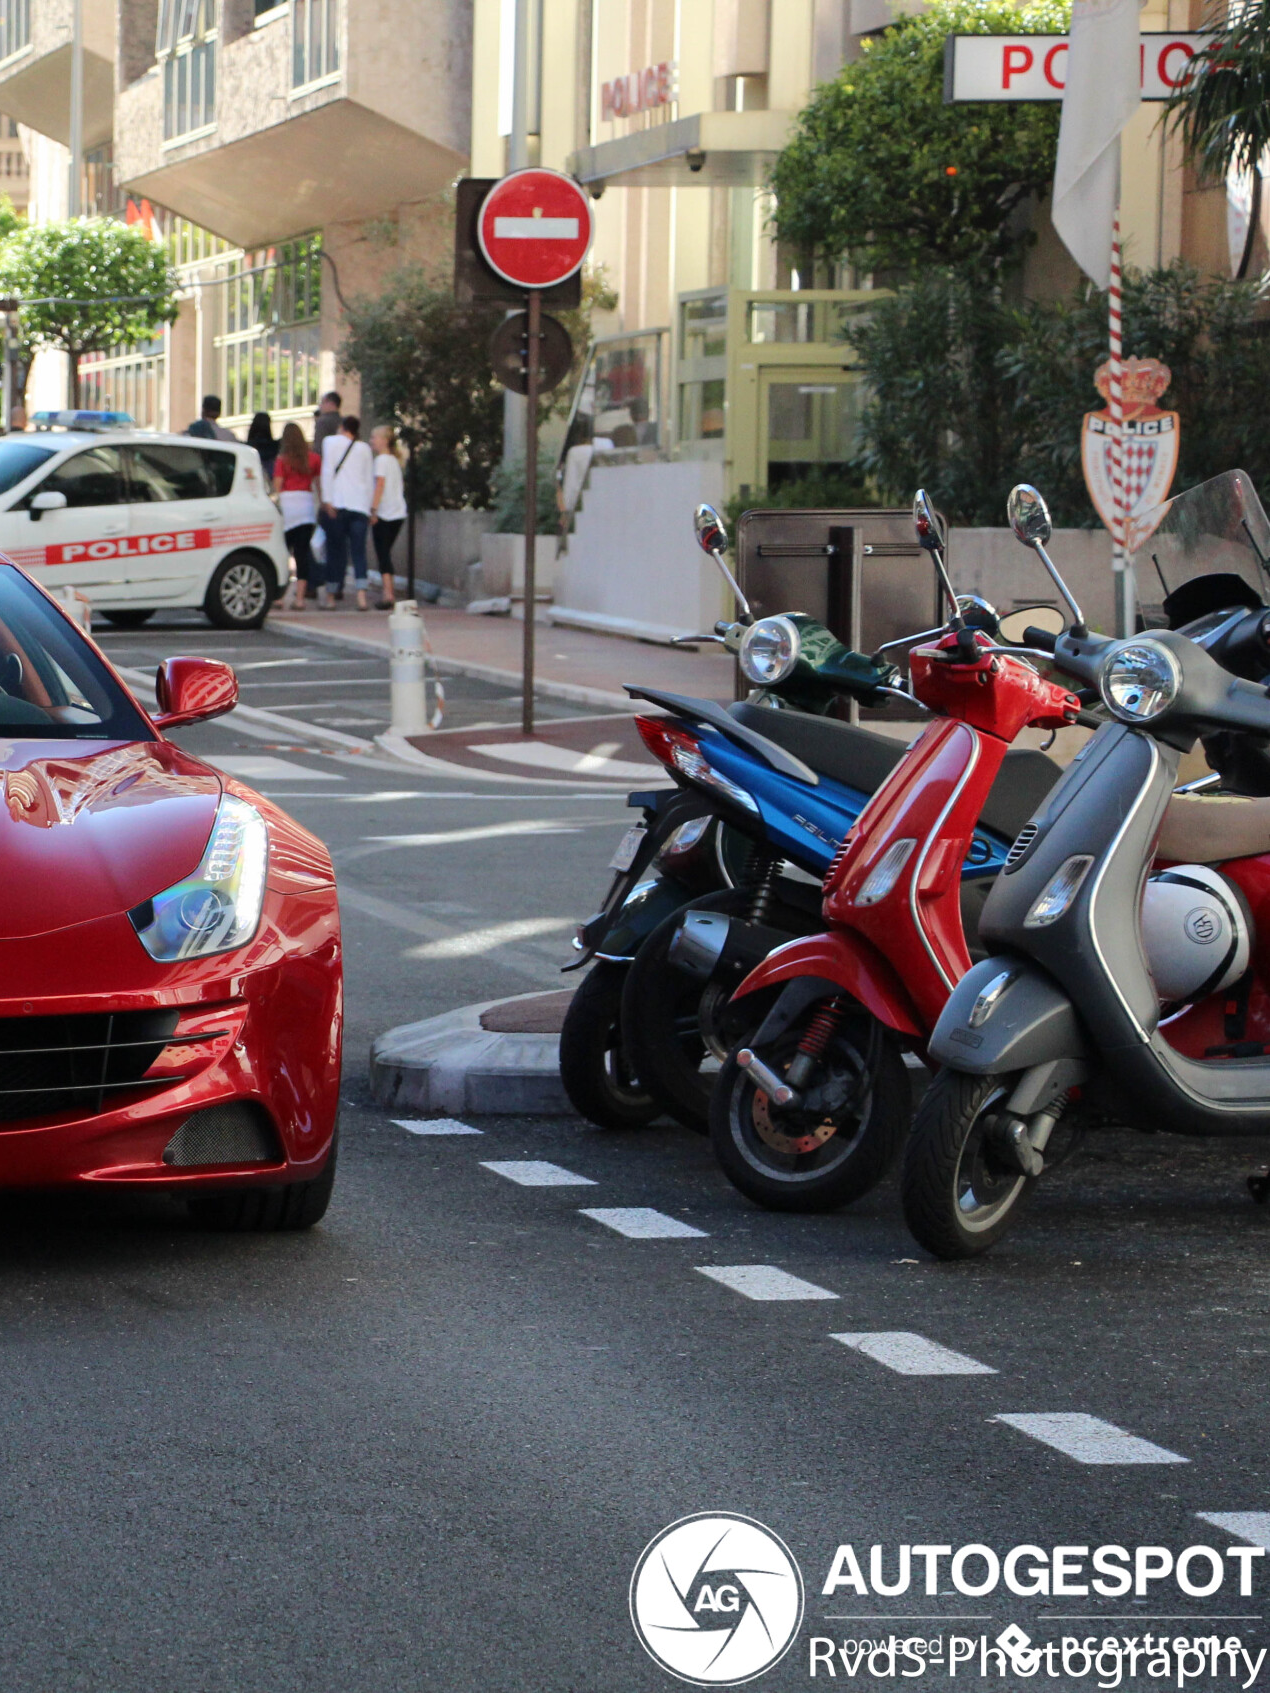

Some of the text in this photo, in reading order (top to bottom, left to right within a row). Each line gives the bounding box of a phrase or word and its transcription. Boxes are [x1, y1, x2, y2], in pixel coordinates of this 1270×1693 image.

[601, 61, 675, 121] POLICE
[1089, 415, 1175, 435] POLICE
[62, 533, 196, 562] POLICE
[792, 813, 842, 850] AGILIT
